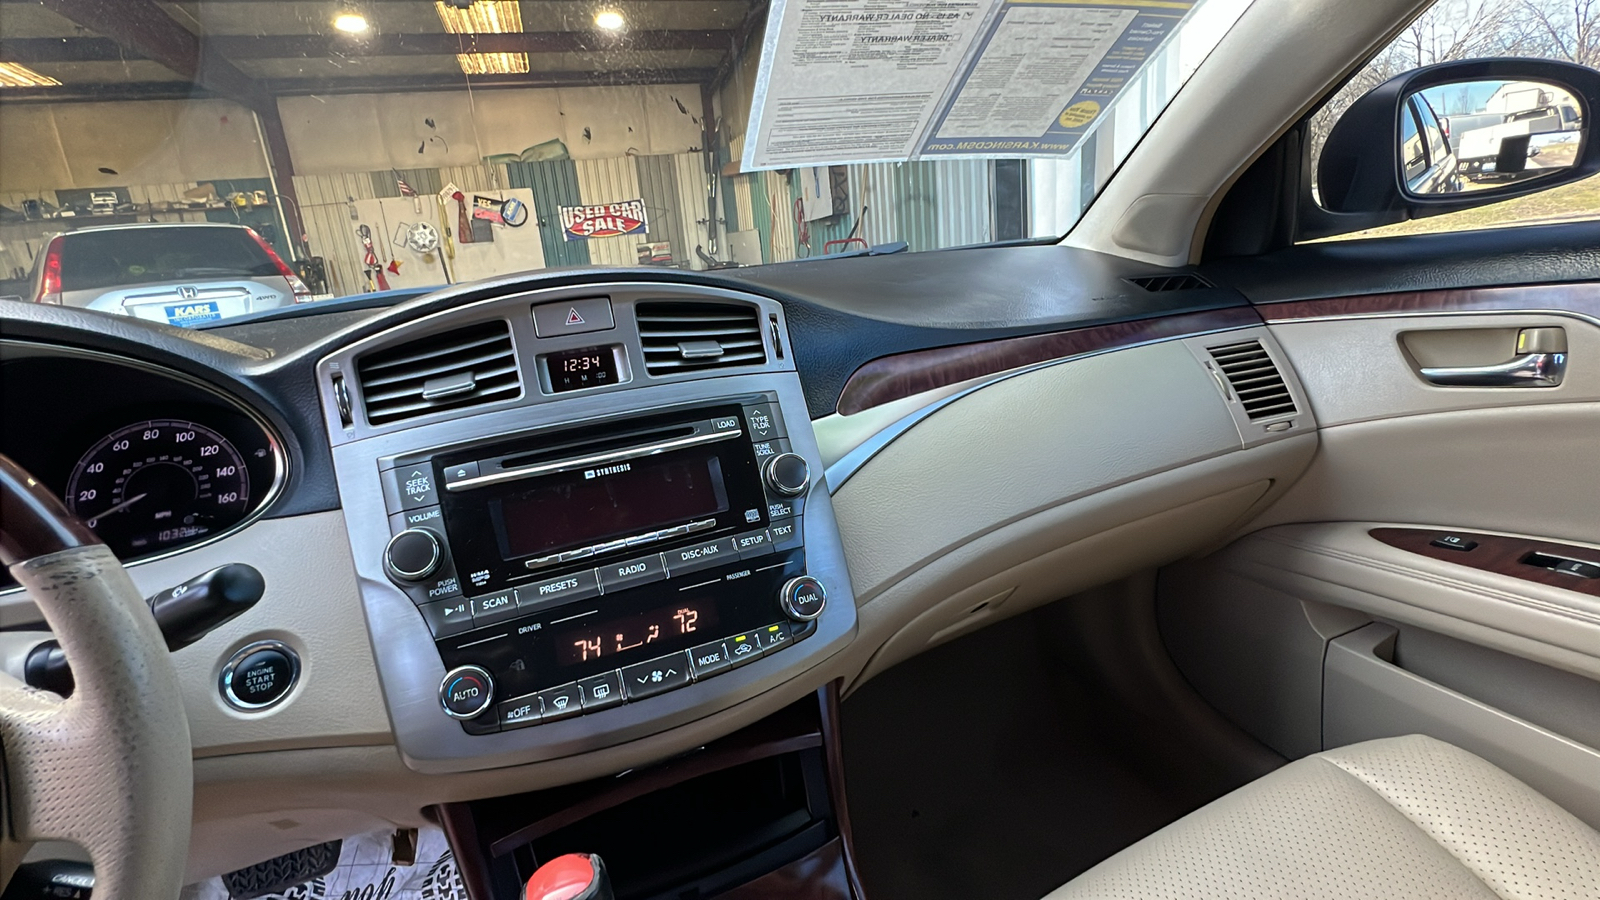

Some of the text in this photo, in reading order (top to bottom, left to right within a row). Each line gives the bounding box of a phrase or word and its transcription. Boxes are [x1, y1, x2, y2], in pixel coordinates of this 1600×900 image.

[477, 198, 492, 209] YES
[562, 202, 644, 228] USED CAR
[582, 218, 627, 236] SALE
[174, 304, 210, 317] KARS
[564, 356, 600, 372] 12:34
[717, 420, 736, 429] LOAD
[143, 430, 160, 440] 80
[176, 431, 196, 443] 100
[112, 440, 130, 451] 60
[200, 445, 219, 456] 120
[757, 448, 774, 456] SCROLL
[86, 462, 104, 473] 40
[216, 466, 236, 477] 140
[406, 477, 429, 488] SEEK
[80, 490, 97, 500] 20
[406, 485, 431, 495] TRACK
[218, 492, 237, 504] 160
[408, 510, 440, 523] VOLUME
[771, 507, 791, 516] SELECT
[773, 525, 792, 535] TEXT
[740, 535, 763, 547] SETUP
[619, 563, 646, 576] RADIO
[726, 570, 751, 580] PASSENGER
[438, 578, 455, 587] PUSH
[539, 579, 578, 595] PRESETS
[429, 584, 458, 597] POWER
[483, 596, 508, 610] SCAN
[798, 593, 818, 604] DUAL
[673, 610, 698, 633] 72
[518, 623, 542, 634] DRIVER
[770, 632, 784, 643] A/C
[574, 636, 600, 661] 74
[698, 653, 720, 666] MODE
[247, 666, 274, 678] ENGINE
[246, 674, 275, 686] START
[250, 682, 273, 694] STOP
[453, 687, 479, 702] AUTO
[513, 705, 531, 718] OFF
